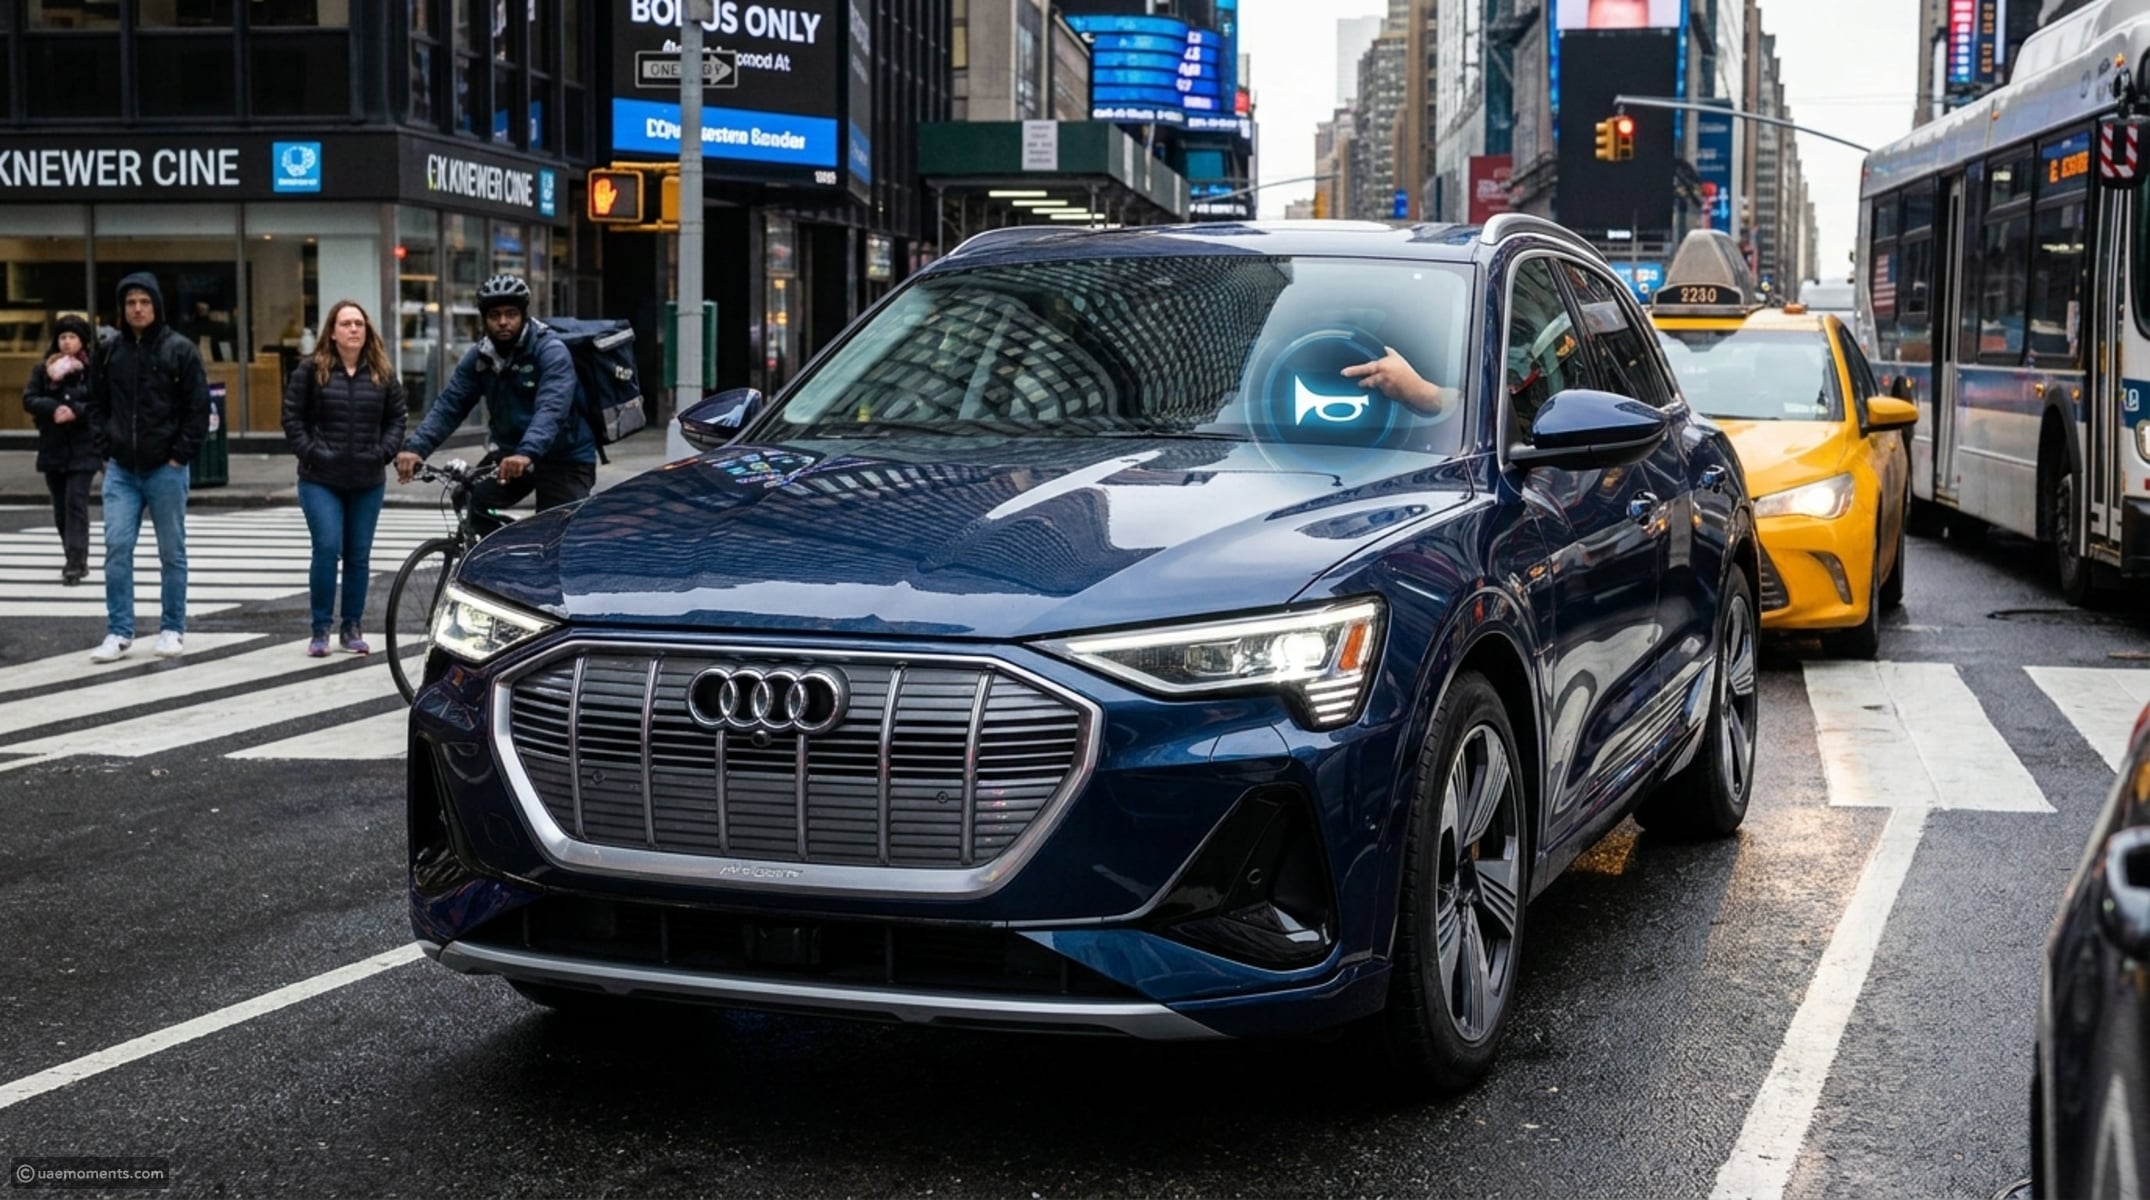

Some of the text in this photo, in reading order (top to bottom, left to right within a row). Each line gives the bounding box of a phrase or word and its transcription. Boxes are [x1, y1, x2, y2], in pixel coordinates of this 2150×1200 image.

[745, 6, 822, 44] ONLY
[650, 63, 678, 76] ONE
[153, 149, 240, 186] CINE
